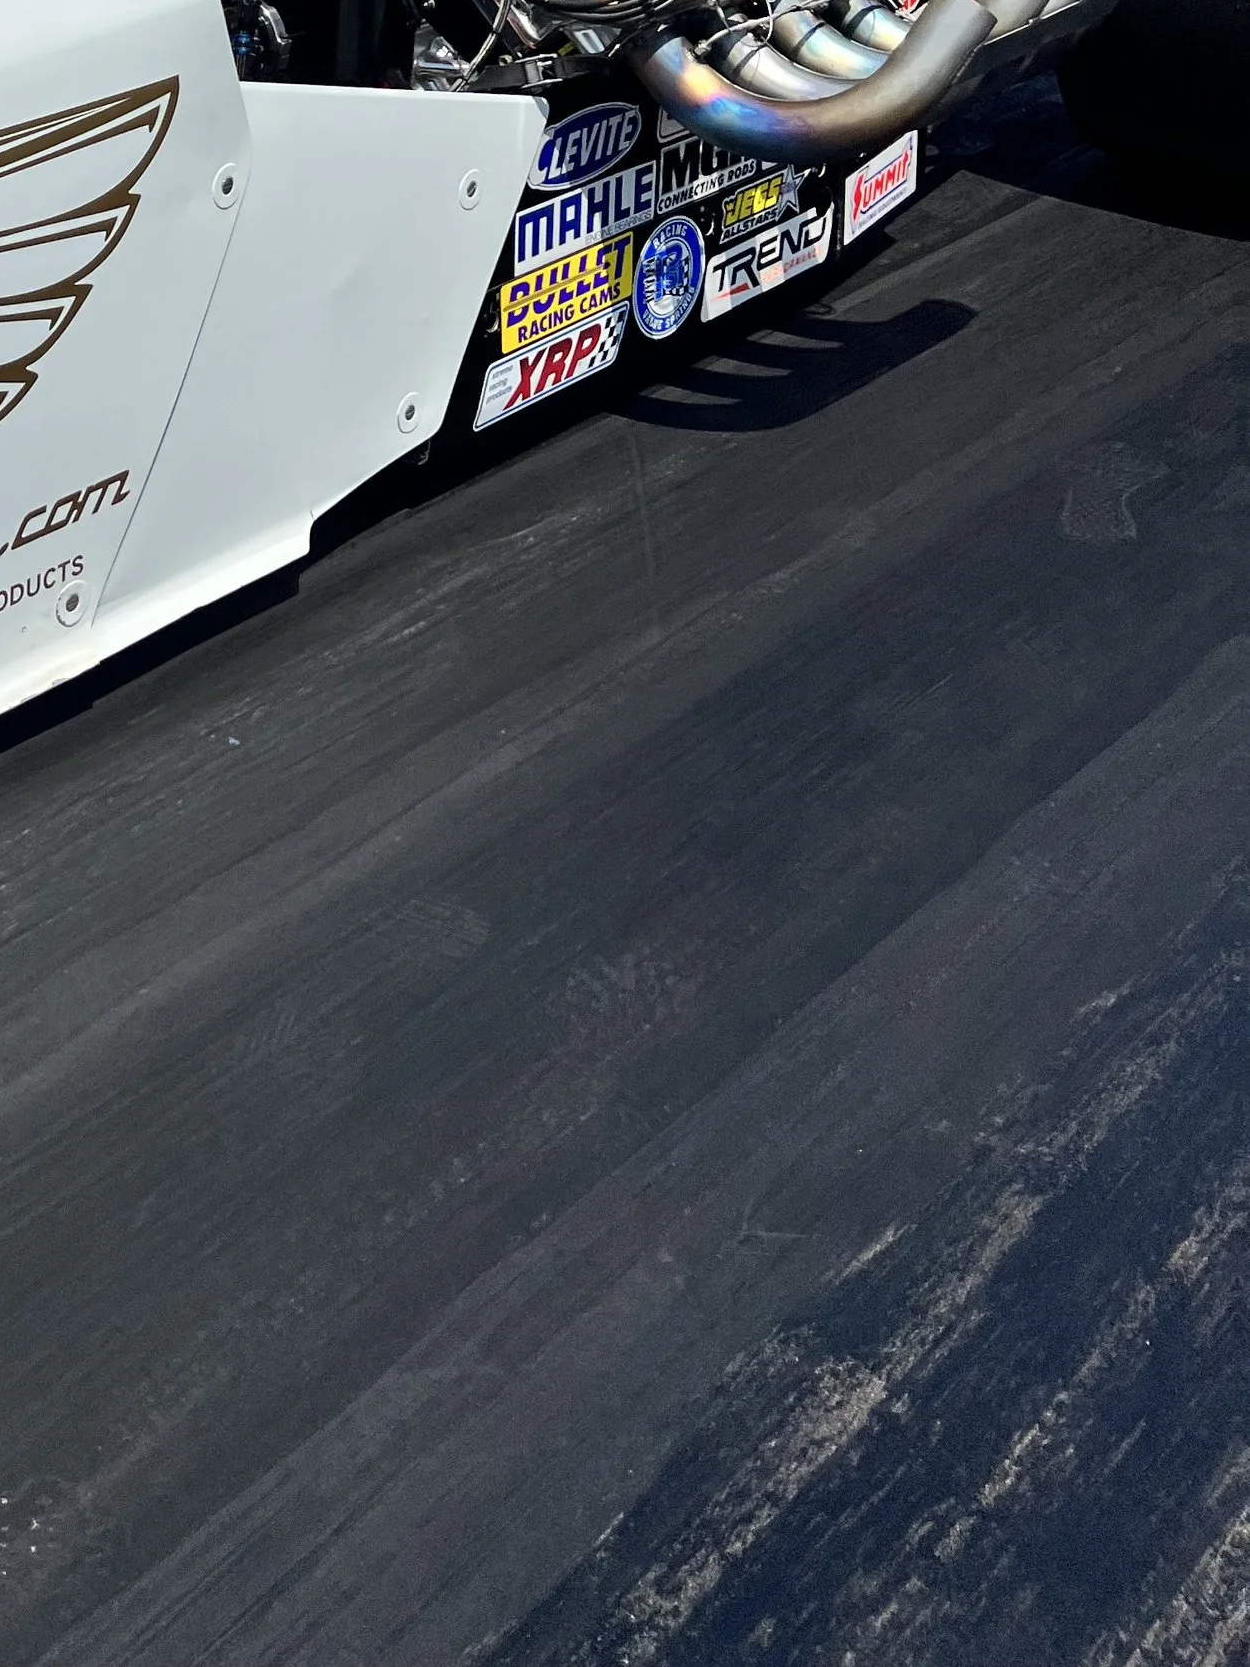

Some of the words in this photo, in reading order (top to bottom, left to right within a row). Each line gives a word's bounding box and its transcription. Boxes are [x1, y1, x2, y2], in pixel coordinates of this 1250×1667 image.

[530, 109, 638, 186] CLEVITE
[661, 141, 741, 196] MG
[517, 166, 653, 264] MAHLE
[657, 174, 725, 211] CONNECTING
[726, 161, 756, 183] RODS
[724, 175, 784, 227] JEGS
[652, 224, 688, 249] RACING
[712, 214, 828, 293] TREND
[722, 207, 779, 242] ALLSTARS
[506, 237, 632, 328] BULLET
[518, 306, 575, 344] RACING
[579, 282, 621, 314] CAMS
[502, 324, 602, 411] XRP
